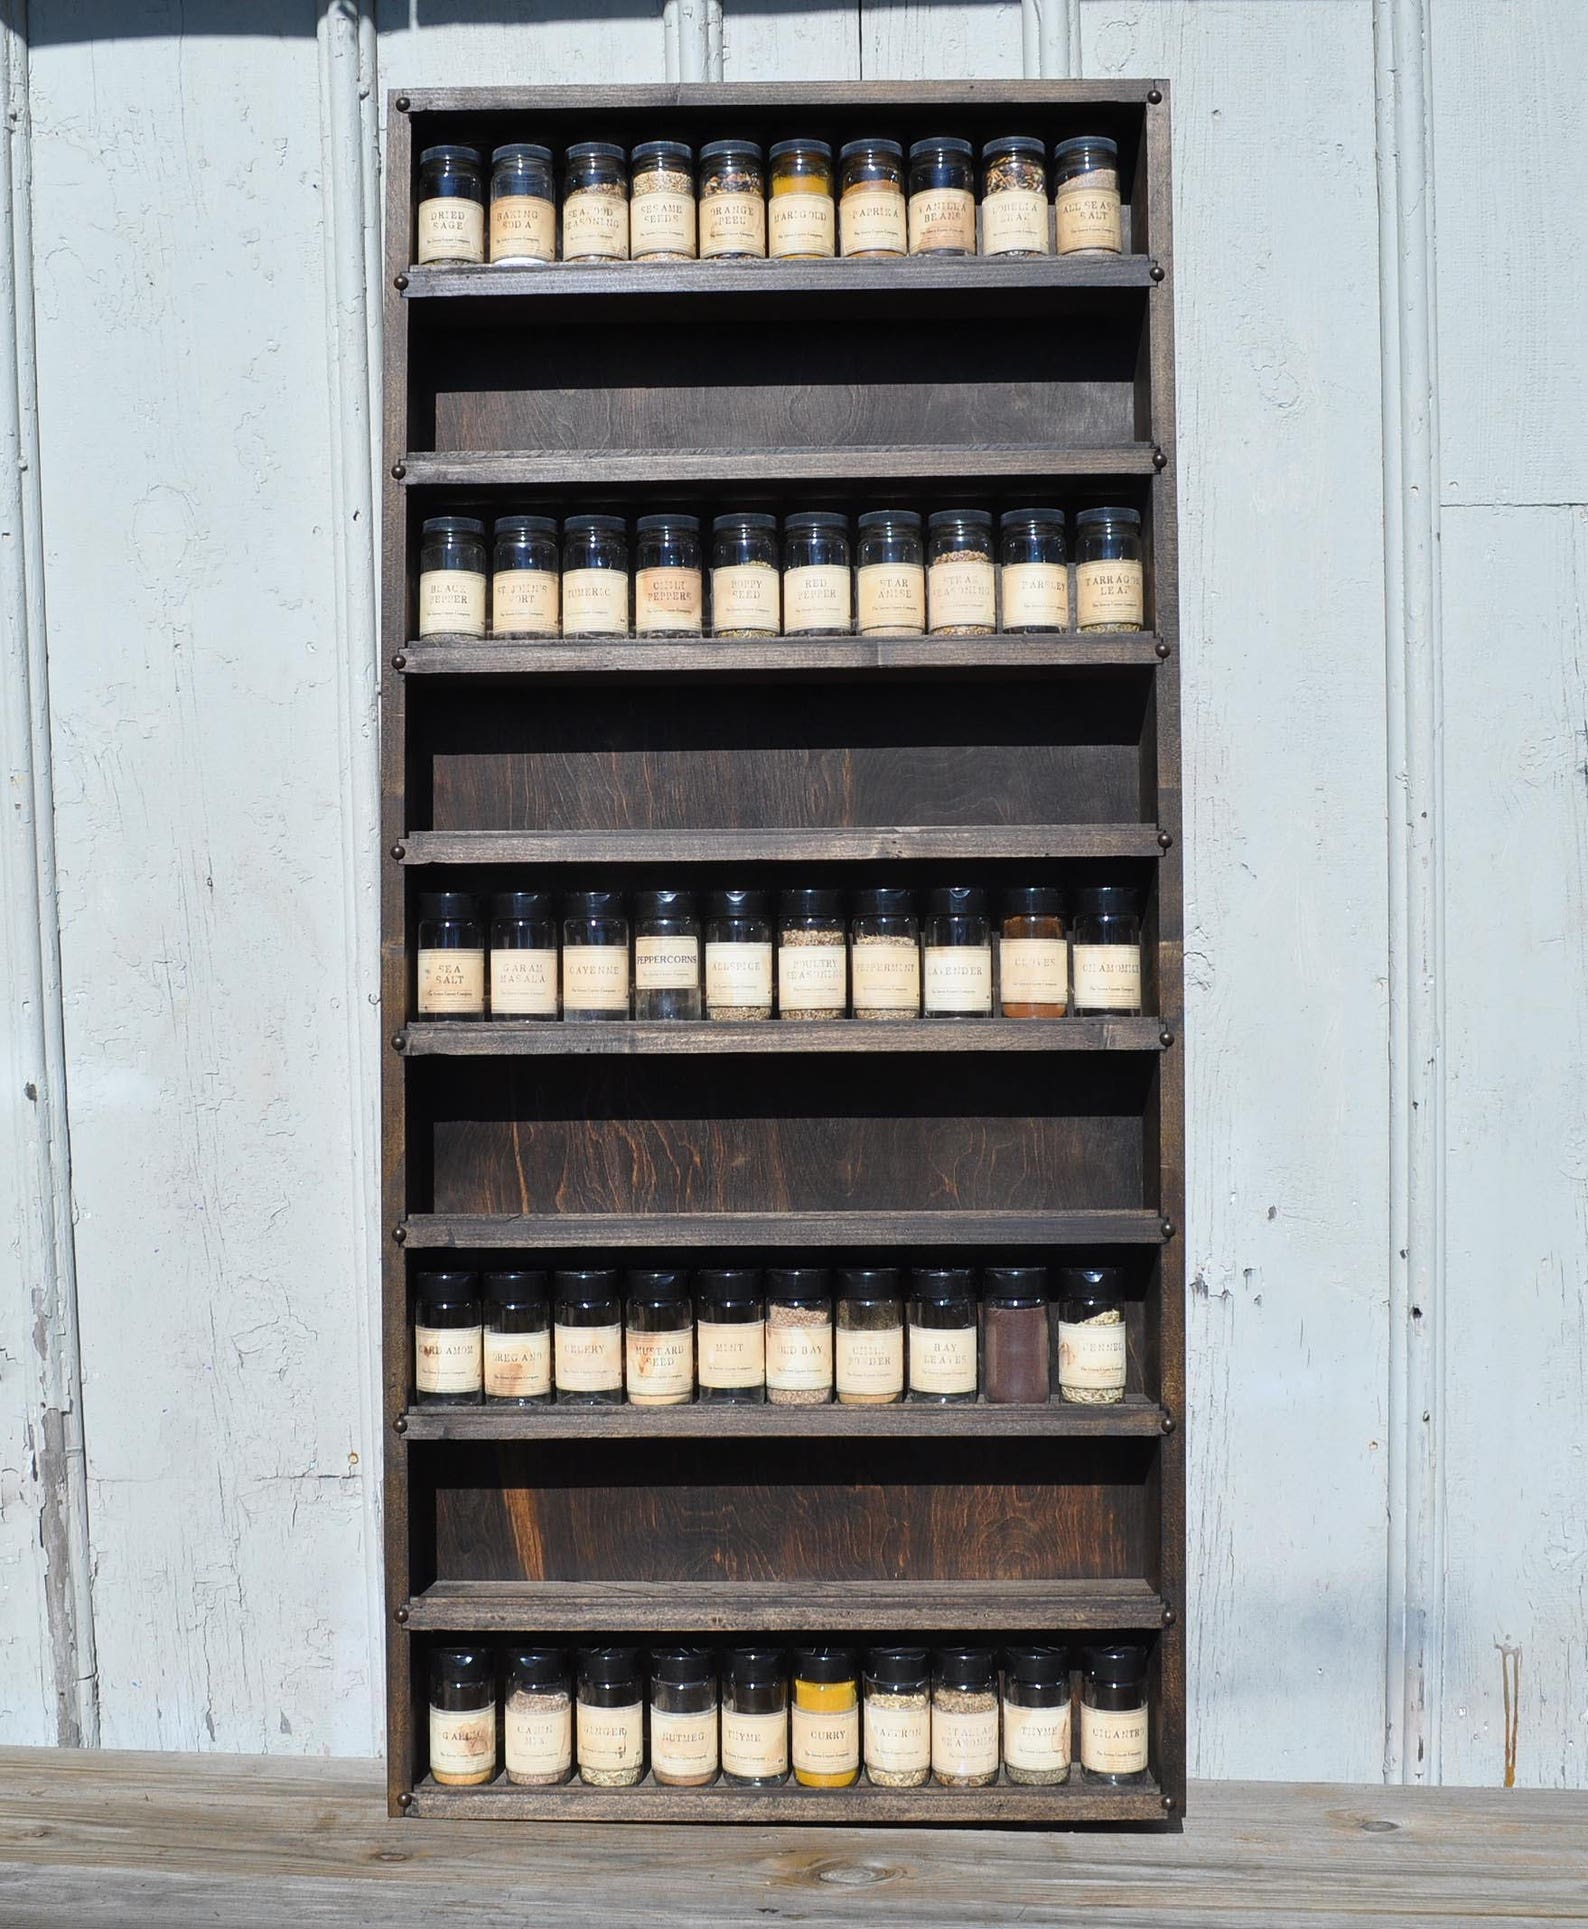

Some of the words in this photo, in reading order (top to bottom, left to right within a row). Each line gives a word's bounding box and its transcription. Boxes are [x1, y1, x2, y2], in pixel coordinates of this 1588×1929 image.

[641, 203, 682, 214] SESAME
[710, 205, 754, 216] ORANGE
[433, 222, 463, 230] SAGE
[880, 579, 908, 588] STAR
[637, 955, 697, 965] PEPPERCORNS
[439, 964, 461, 973] SEA
[570, 965, 619, 975] CAYENNE
[436, 976, 464, 984] SALT
[662, 1732, 705, 1742] NUTMEG
[810, 1730, 846, 1740] CURRY
